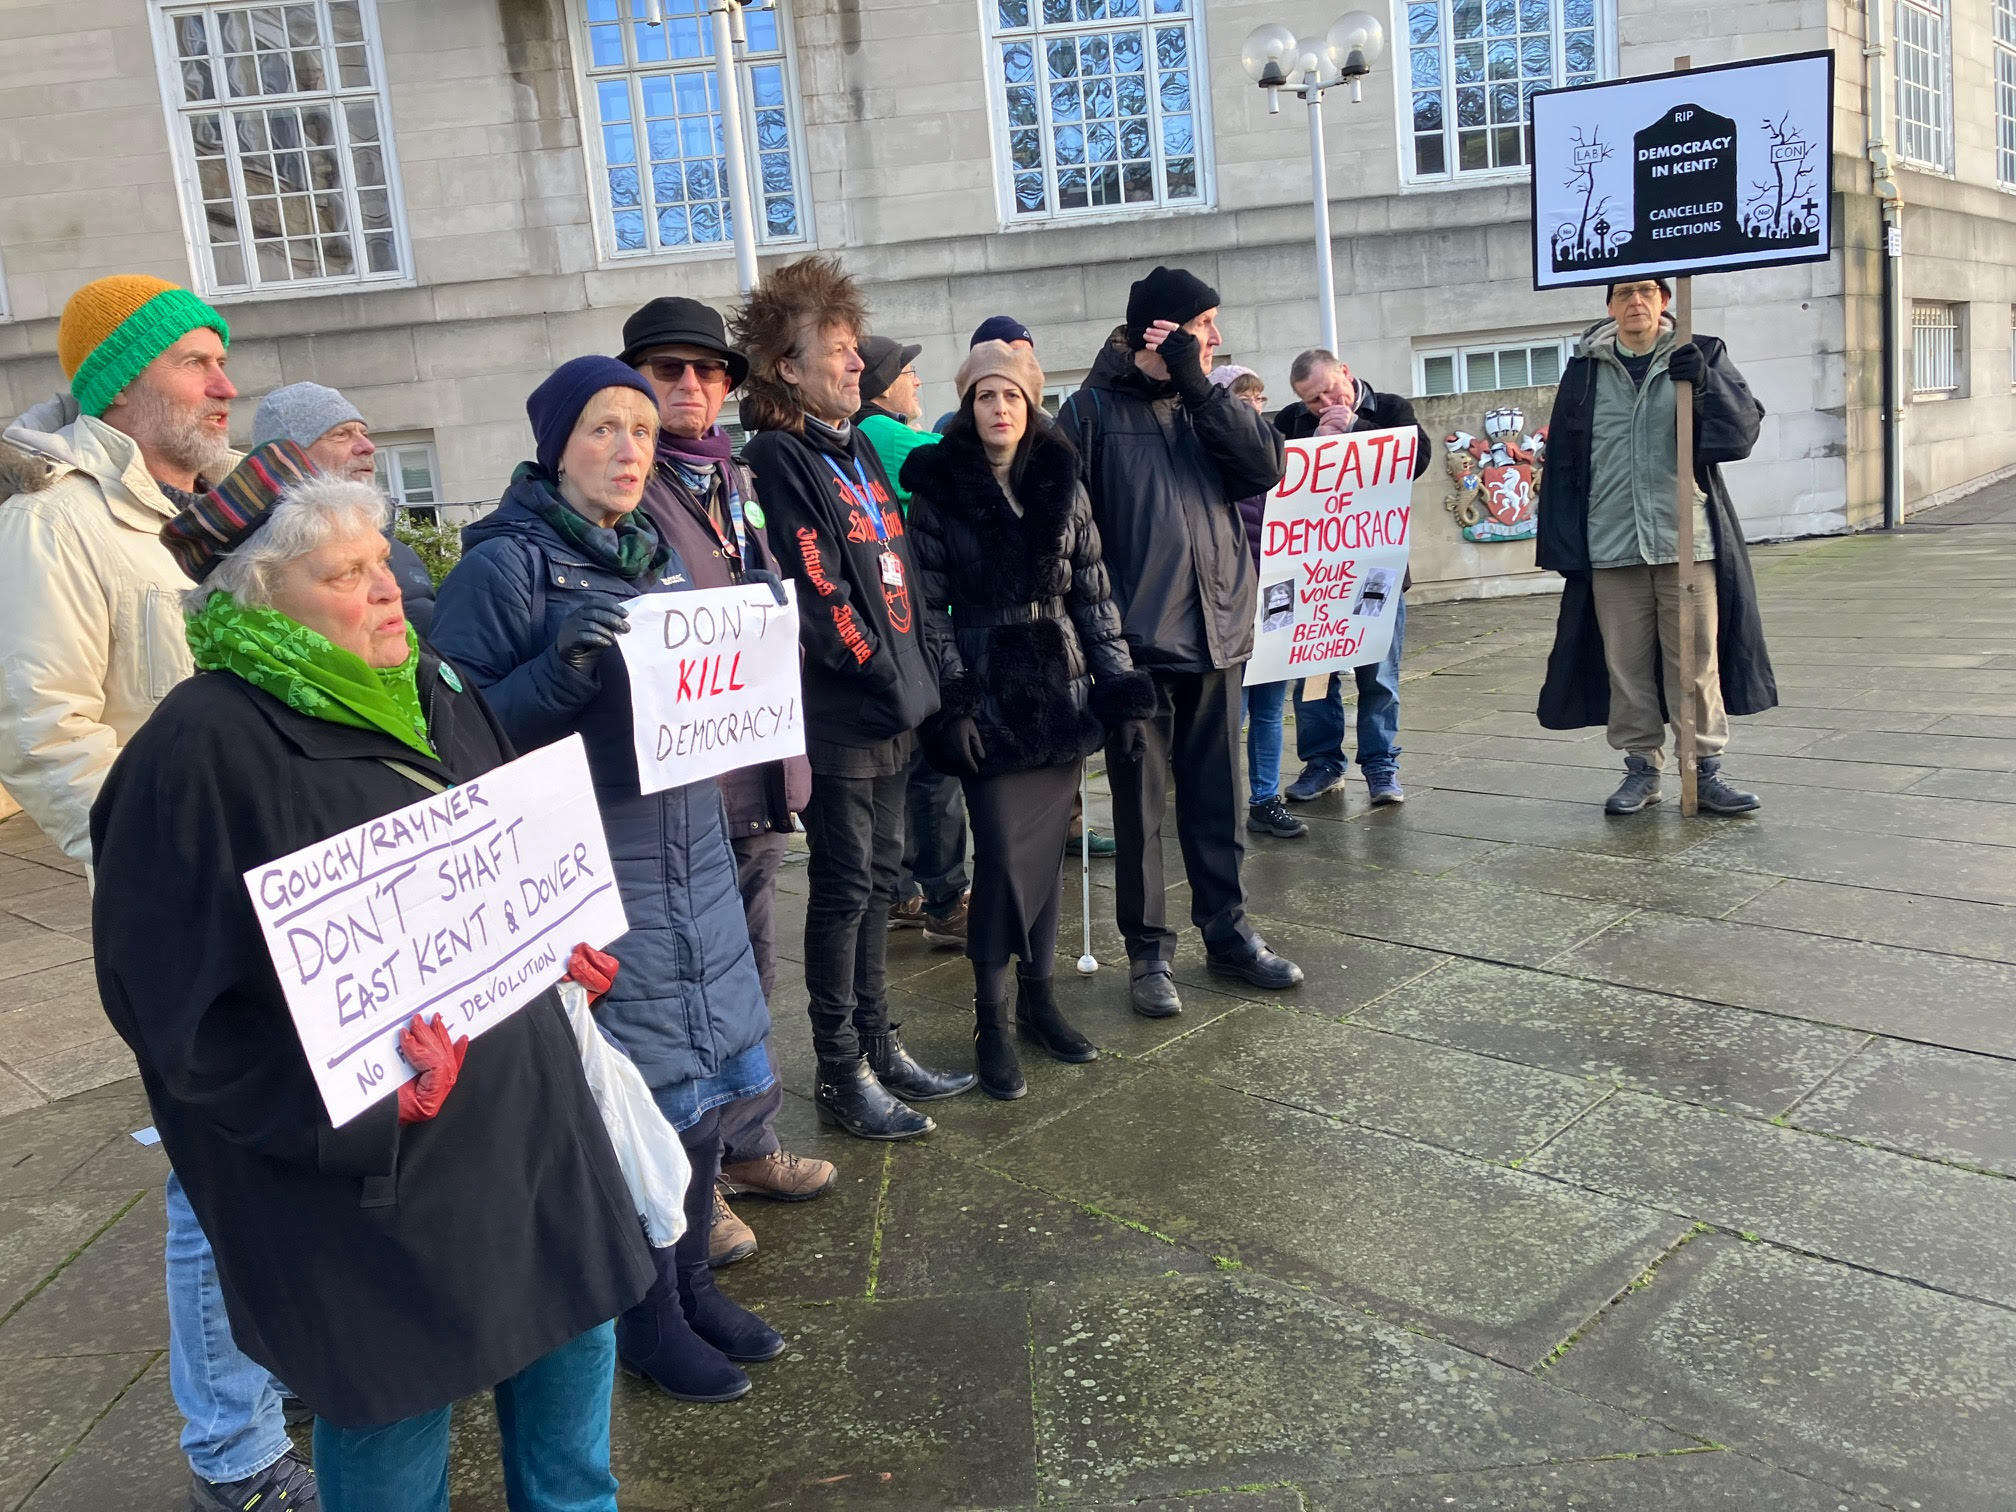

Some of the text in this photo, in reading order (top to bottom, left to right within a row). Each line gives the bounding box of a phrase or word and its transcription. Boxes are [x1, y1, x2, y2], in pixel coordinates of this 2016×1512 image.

[1674, 110, 1694, 123] RIP
[1576, 147, 1599, 162] LAB
[1638, 135, 1732, 162] DEMOCRACY
[1774, 145, 1803, 160] CON
[1651, 157, 1719, 178] IN KENT?
[1649, 201, 1723, 222] CANCELLED
[1652, 220, 1721, 240] ELECTIONS
[1275, 434, 1416, 498] DEATH
[1324, 491, 1353, 514] OF
[1263, 506, 1410, 557] DEMOCRACY
[1302, 558, 1357, 586] YOUR
[1300, 581, 1355, 604] VOICE
[664, 599, 774, 650] DON'T
[1313, 603, 1329, 622] IS
[1293, 618, 1349, 643] BEING
[1288, 627, 1366, 665] HUSHED!
[676, 650, 745, 704] KILL
[656, 697, 794, 762] DEMOCRACY!
[286, 816, 524, 985] DON'T SHAFT
[335, 842, 595, 1027] EAST KENT & DOVER
[460, 943, 558, 1022] DEVOLUTION
